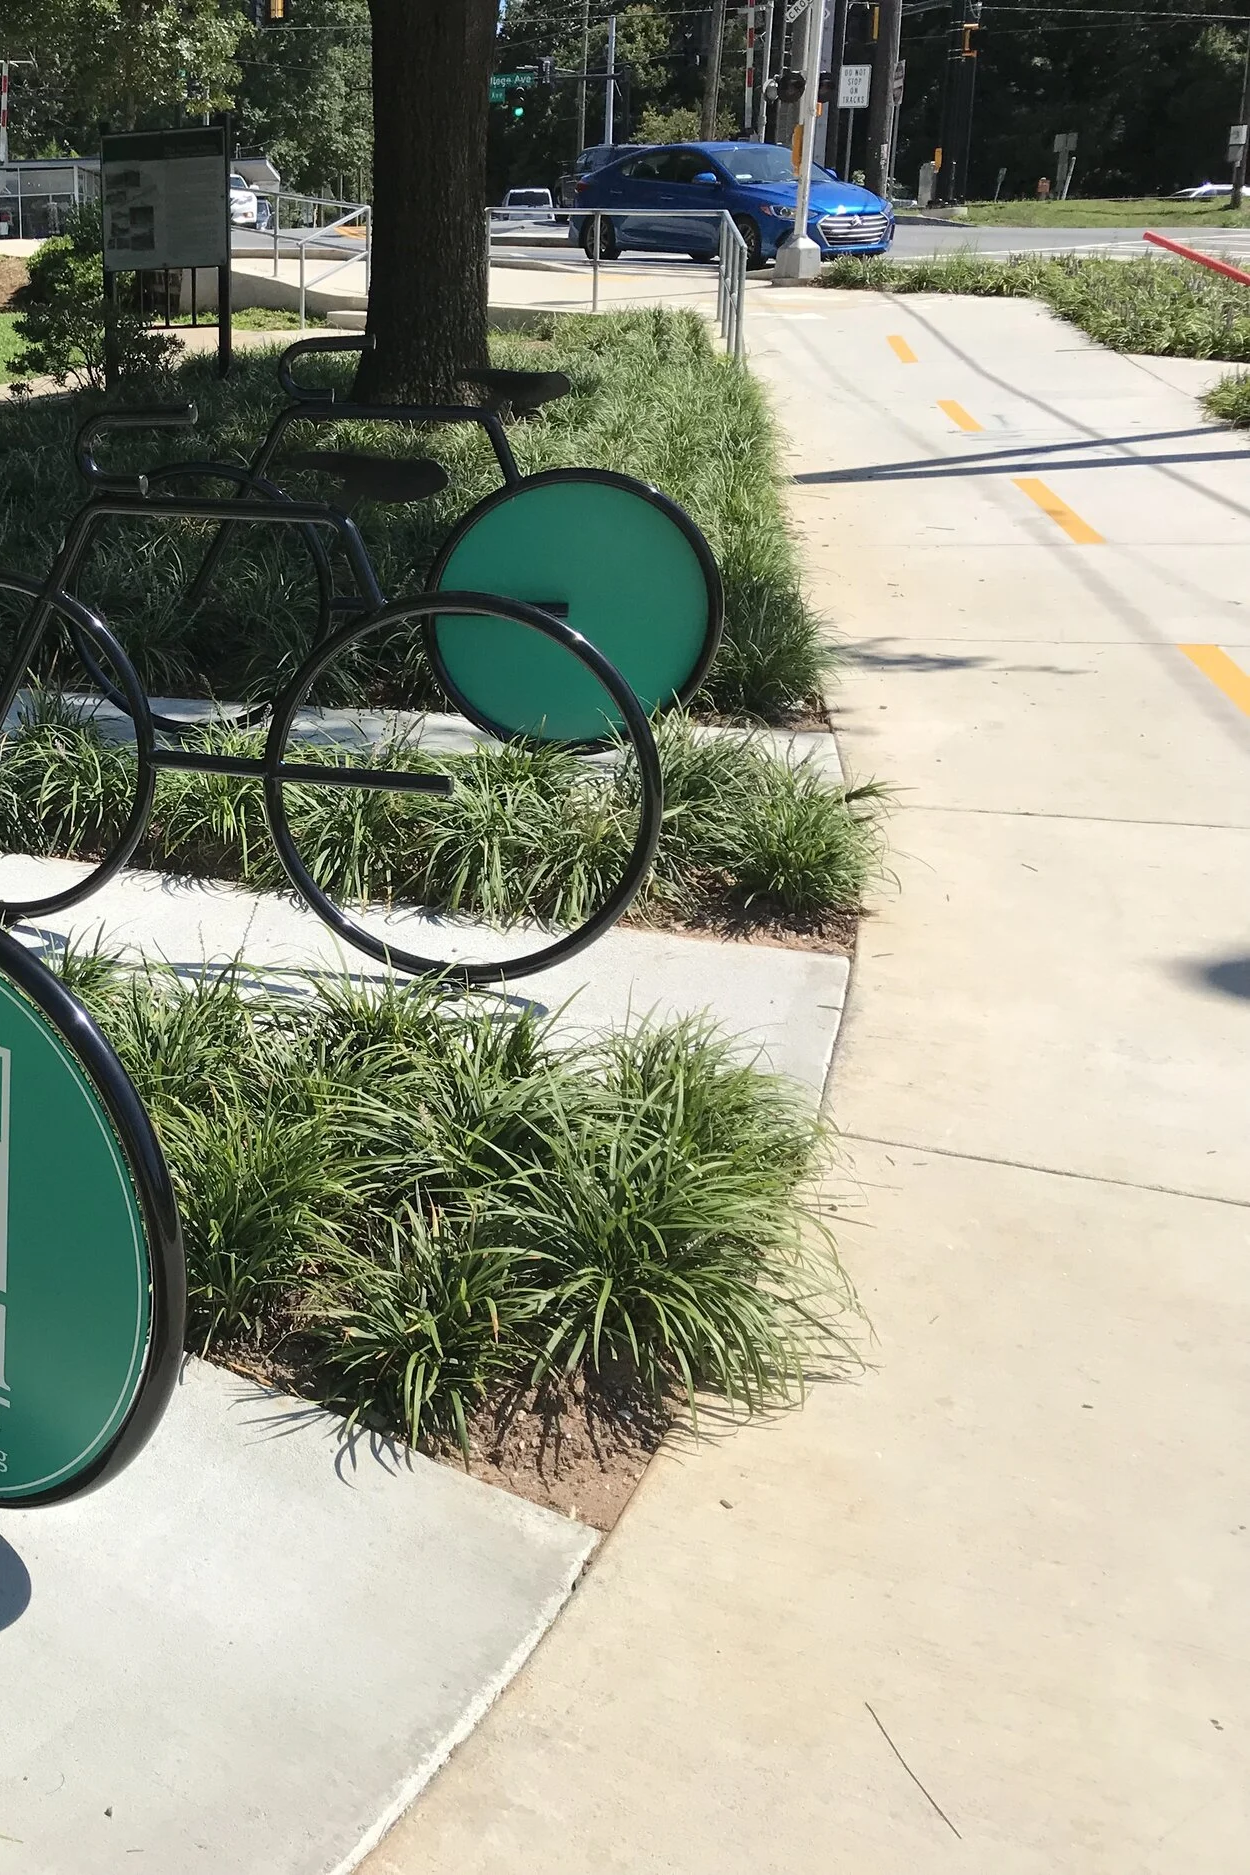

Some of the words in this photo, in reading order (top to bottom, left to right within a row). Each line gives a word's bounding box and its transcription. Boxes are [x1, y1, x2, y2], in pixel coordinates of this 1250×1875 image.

[844, 69, 853, 77] DO
[855, 68, 866, 76] NOT
[515, 74, 532, 84] Ave
[847, 77, 862, 86] STOP
[849, 87, 858, 95] ON
[842, 96, 865, 104] TRACKS
